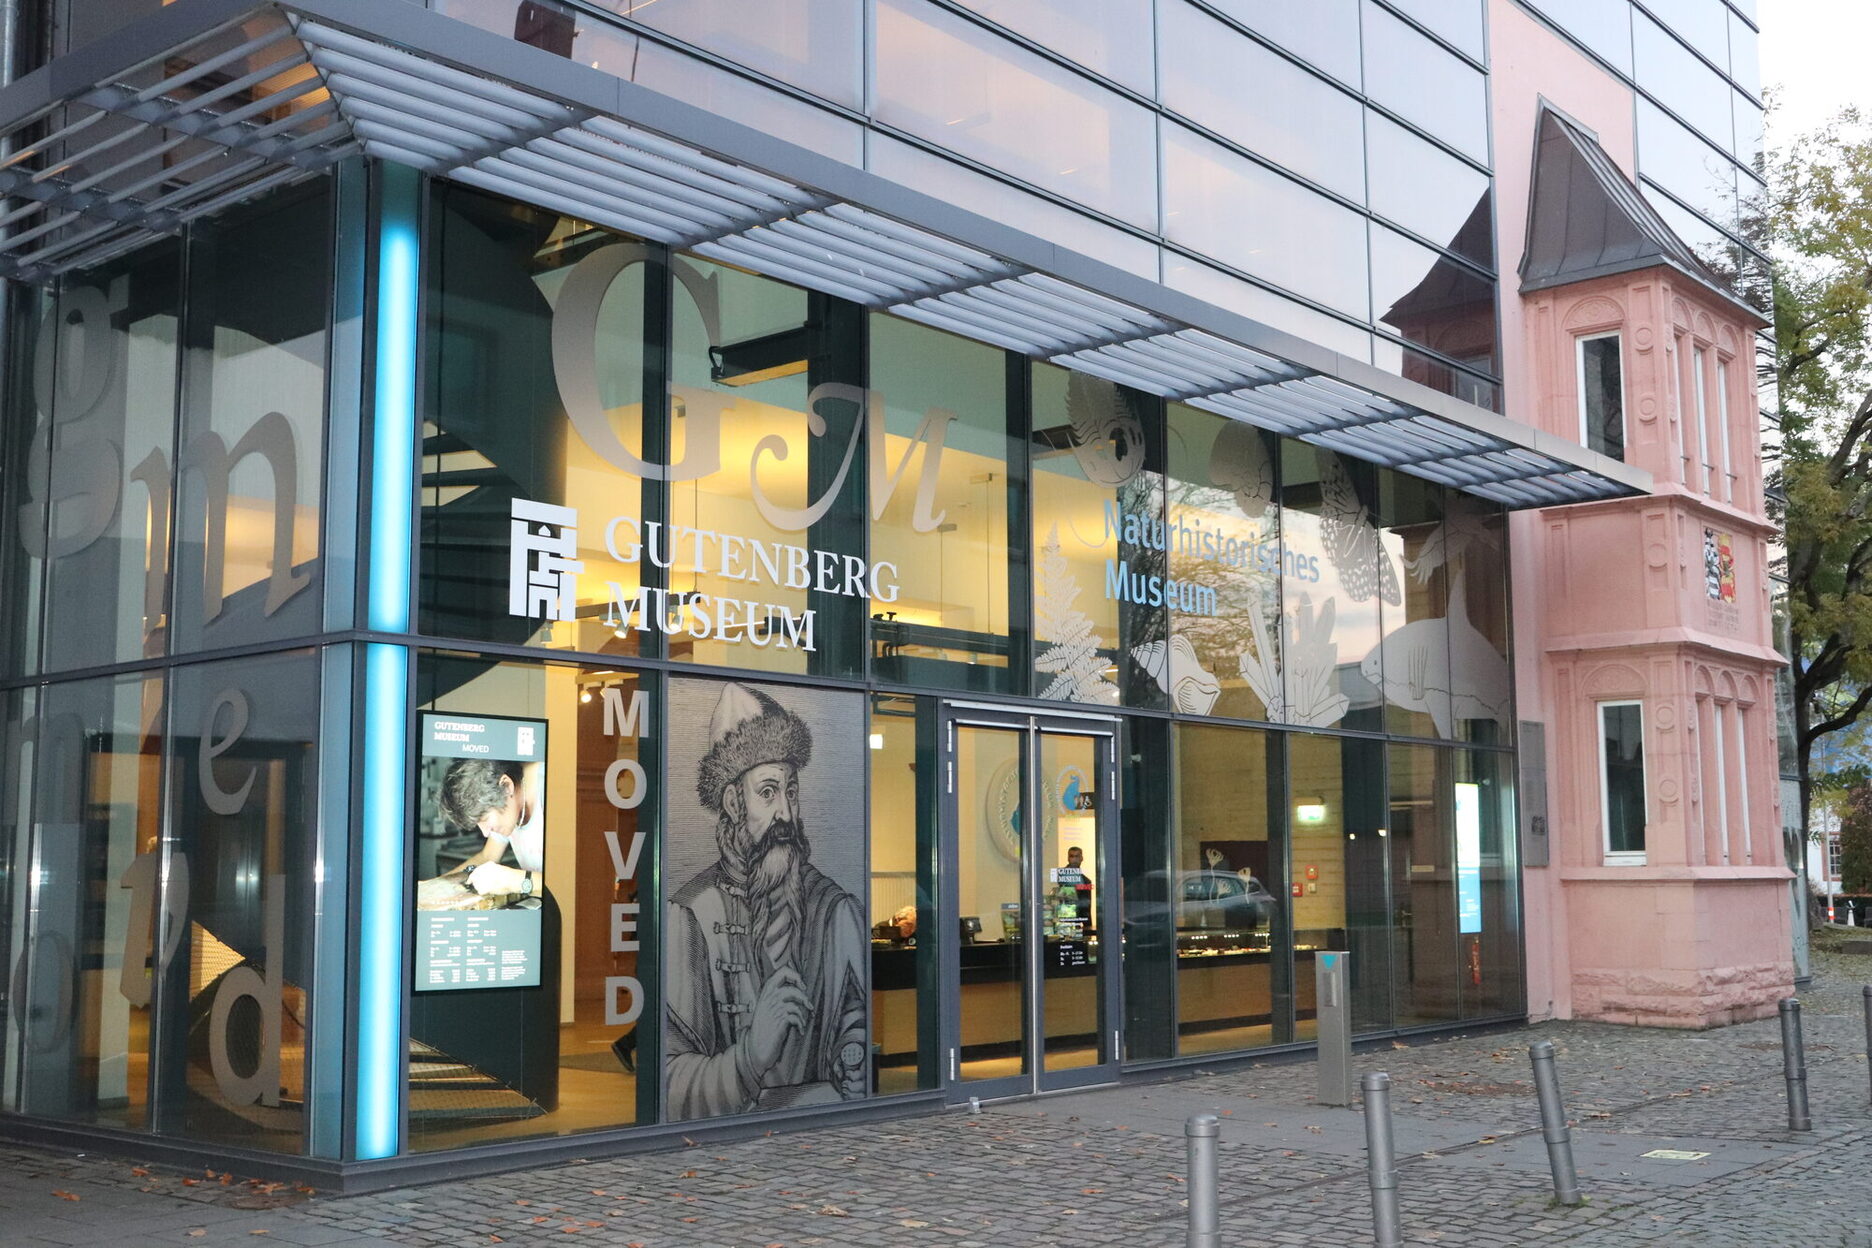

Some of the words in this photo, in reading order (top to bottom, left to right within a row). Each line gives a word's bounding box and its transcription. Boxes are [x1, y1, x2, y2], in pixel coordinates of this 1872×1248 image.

[604, 516, 900, 603] GUTENBERG
[1104, 498, 1320, 583] Naturhistorisches
[603, 581, 817, 652] MUSEUM
[1105, 558, 1217, 616] Museum
[434, 722, 486, 733] GUTENBERG
[434, 732, 470, 742] MUSEUM
[462, 744, 490, 753] MOVED
[603, 689, 649, 1026] MOVED
